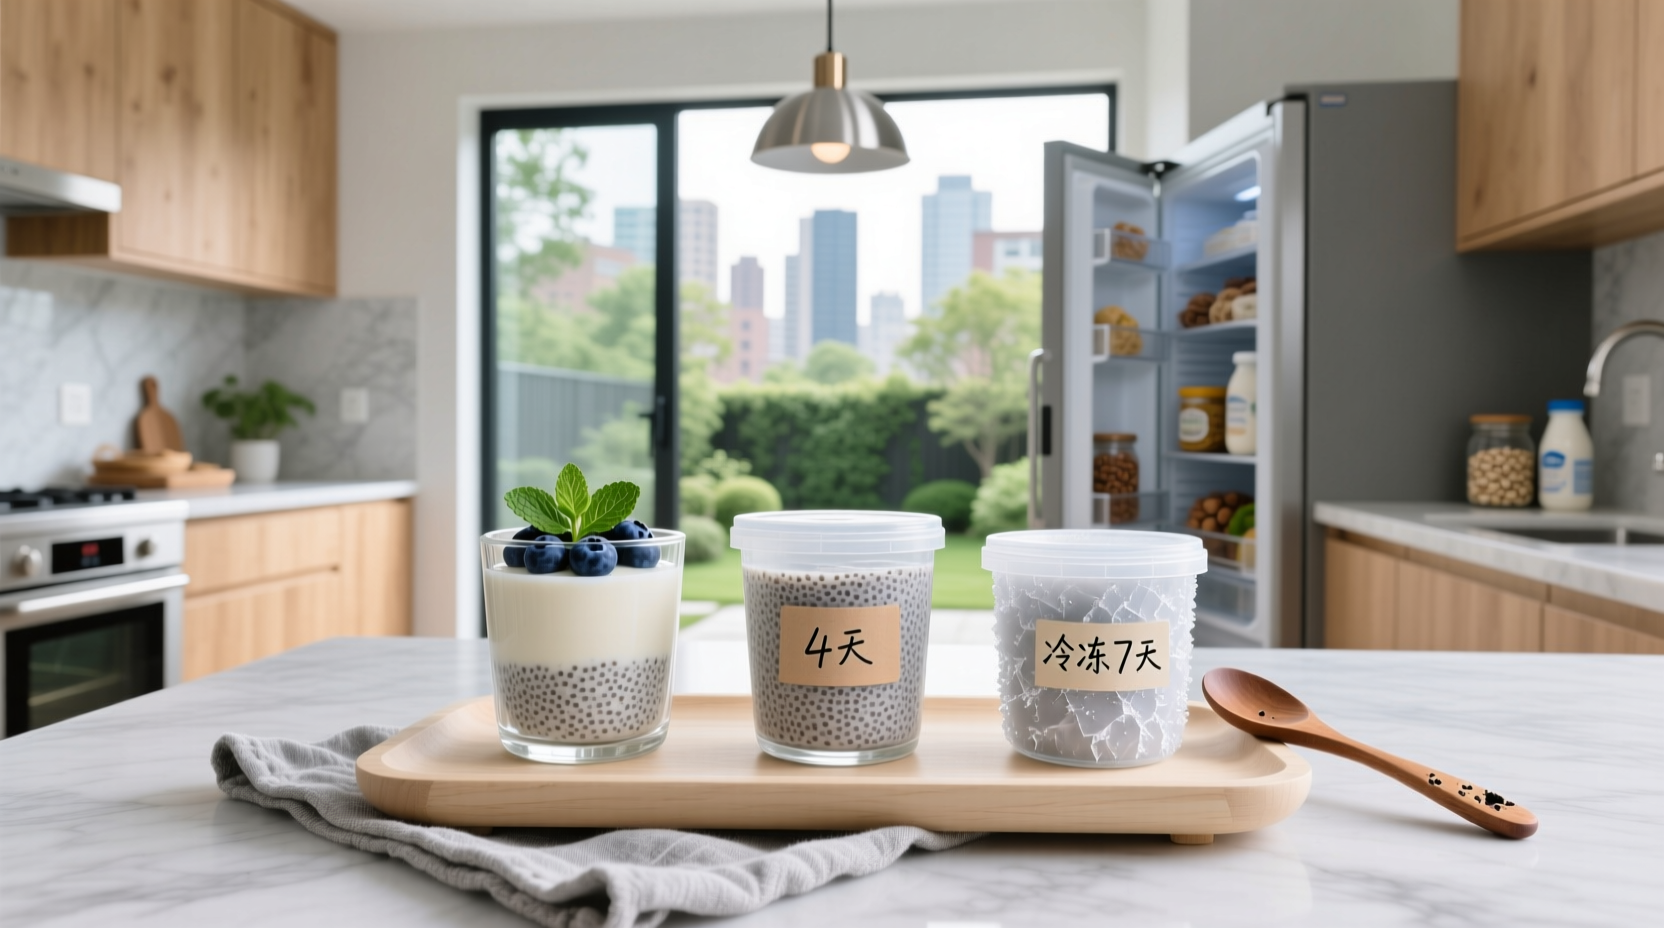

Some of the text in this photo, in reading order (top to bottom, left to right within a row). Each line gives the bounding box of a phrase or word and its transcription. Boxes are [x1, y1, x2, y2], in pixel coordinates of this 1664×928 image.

[804, 626, 873, 669] 4天
[1042, 633, 1162, 675] 冷冻7天
